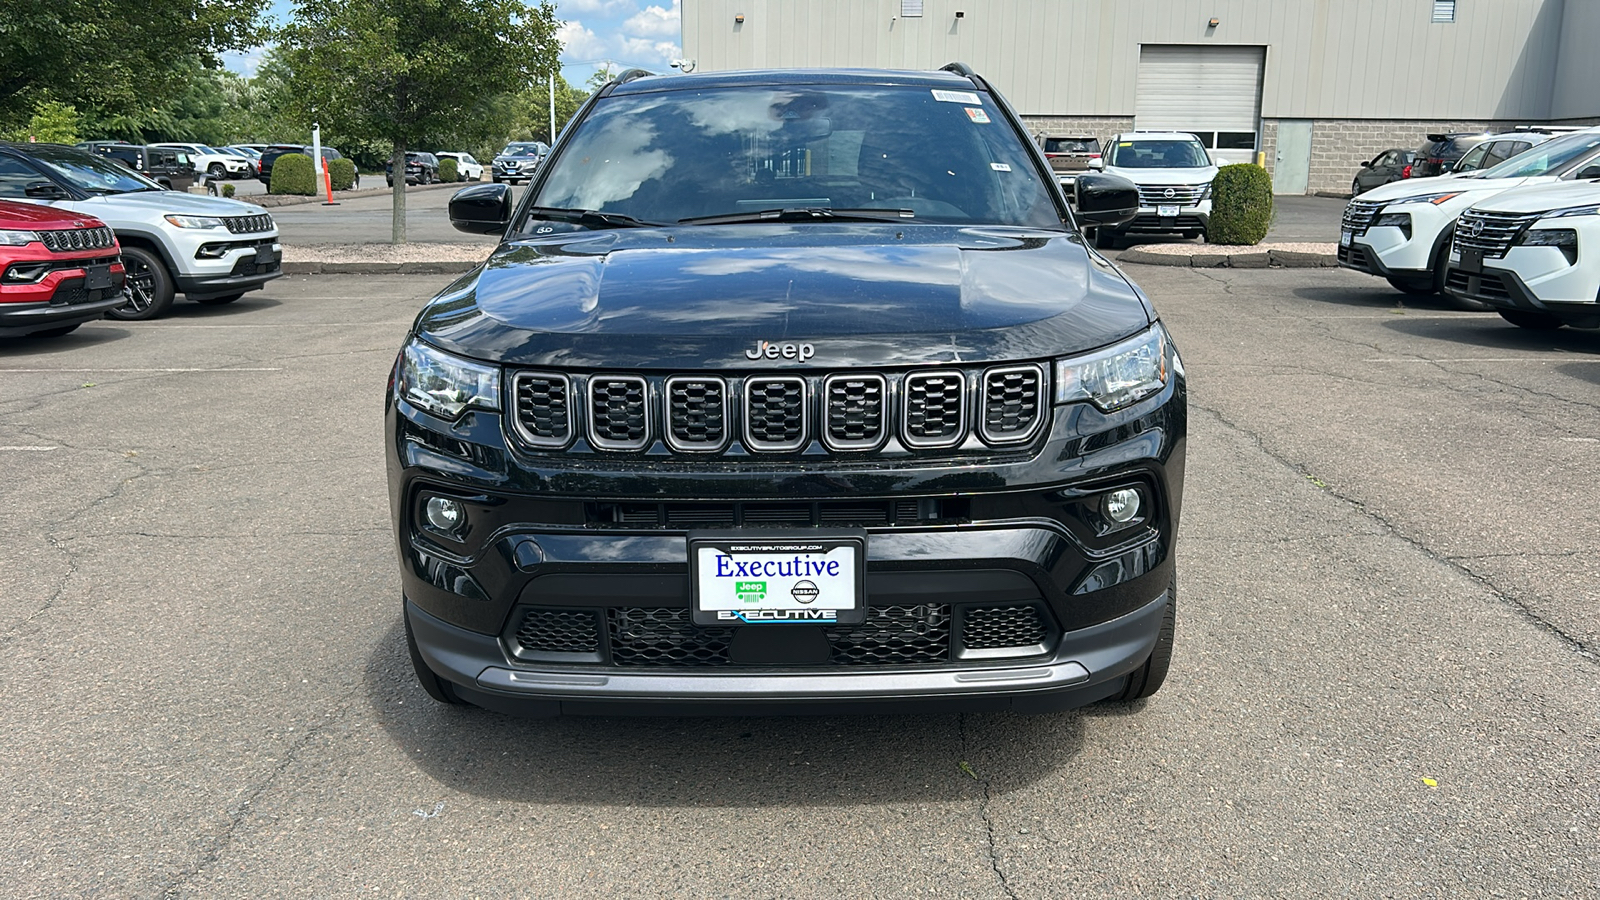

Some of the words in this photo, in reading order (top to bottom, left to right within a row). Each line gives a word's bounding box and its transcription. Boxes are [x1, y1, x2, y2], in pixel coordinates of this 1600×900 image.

[745, 340, 815, 362] Jeep
[715, 554, 840, 577] Executive
[740, 582, 762, 592] Jeep
[717, 610, 838, 620] EXECUTIVE
